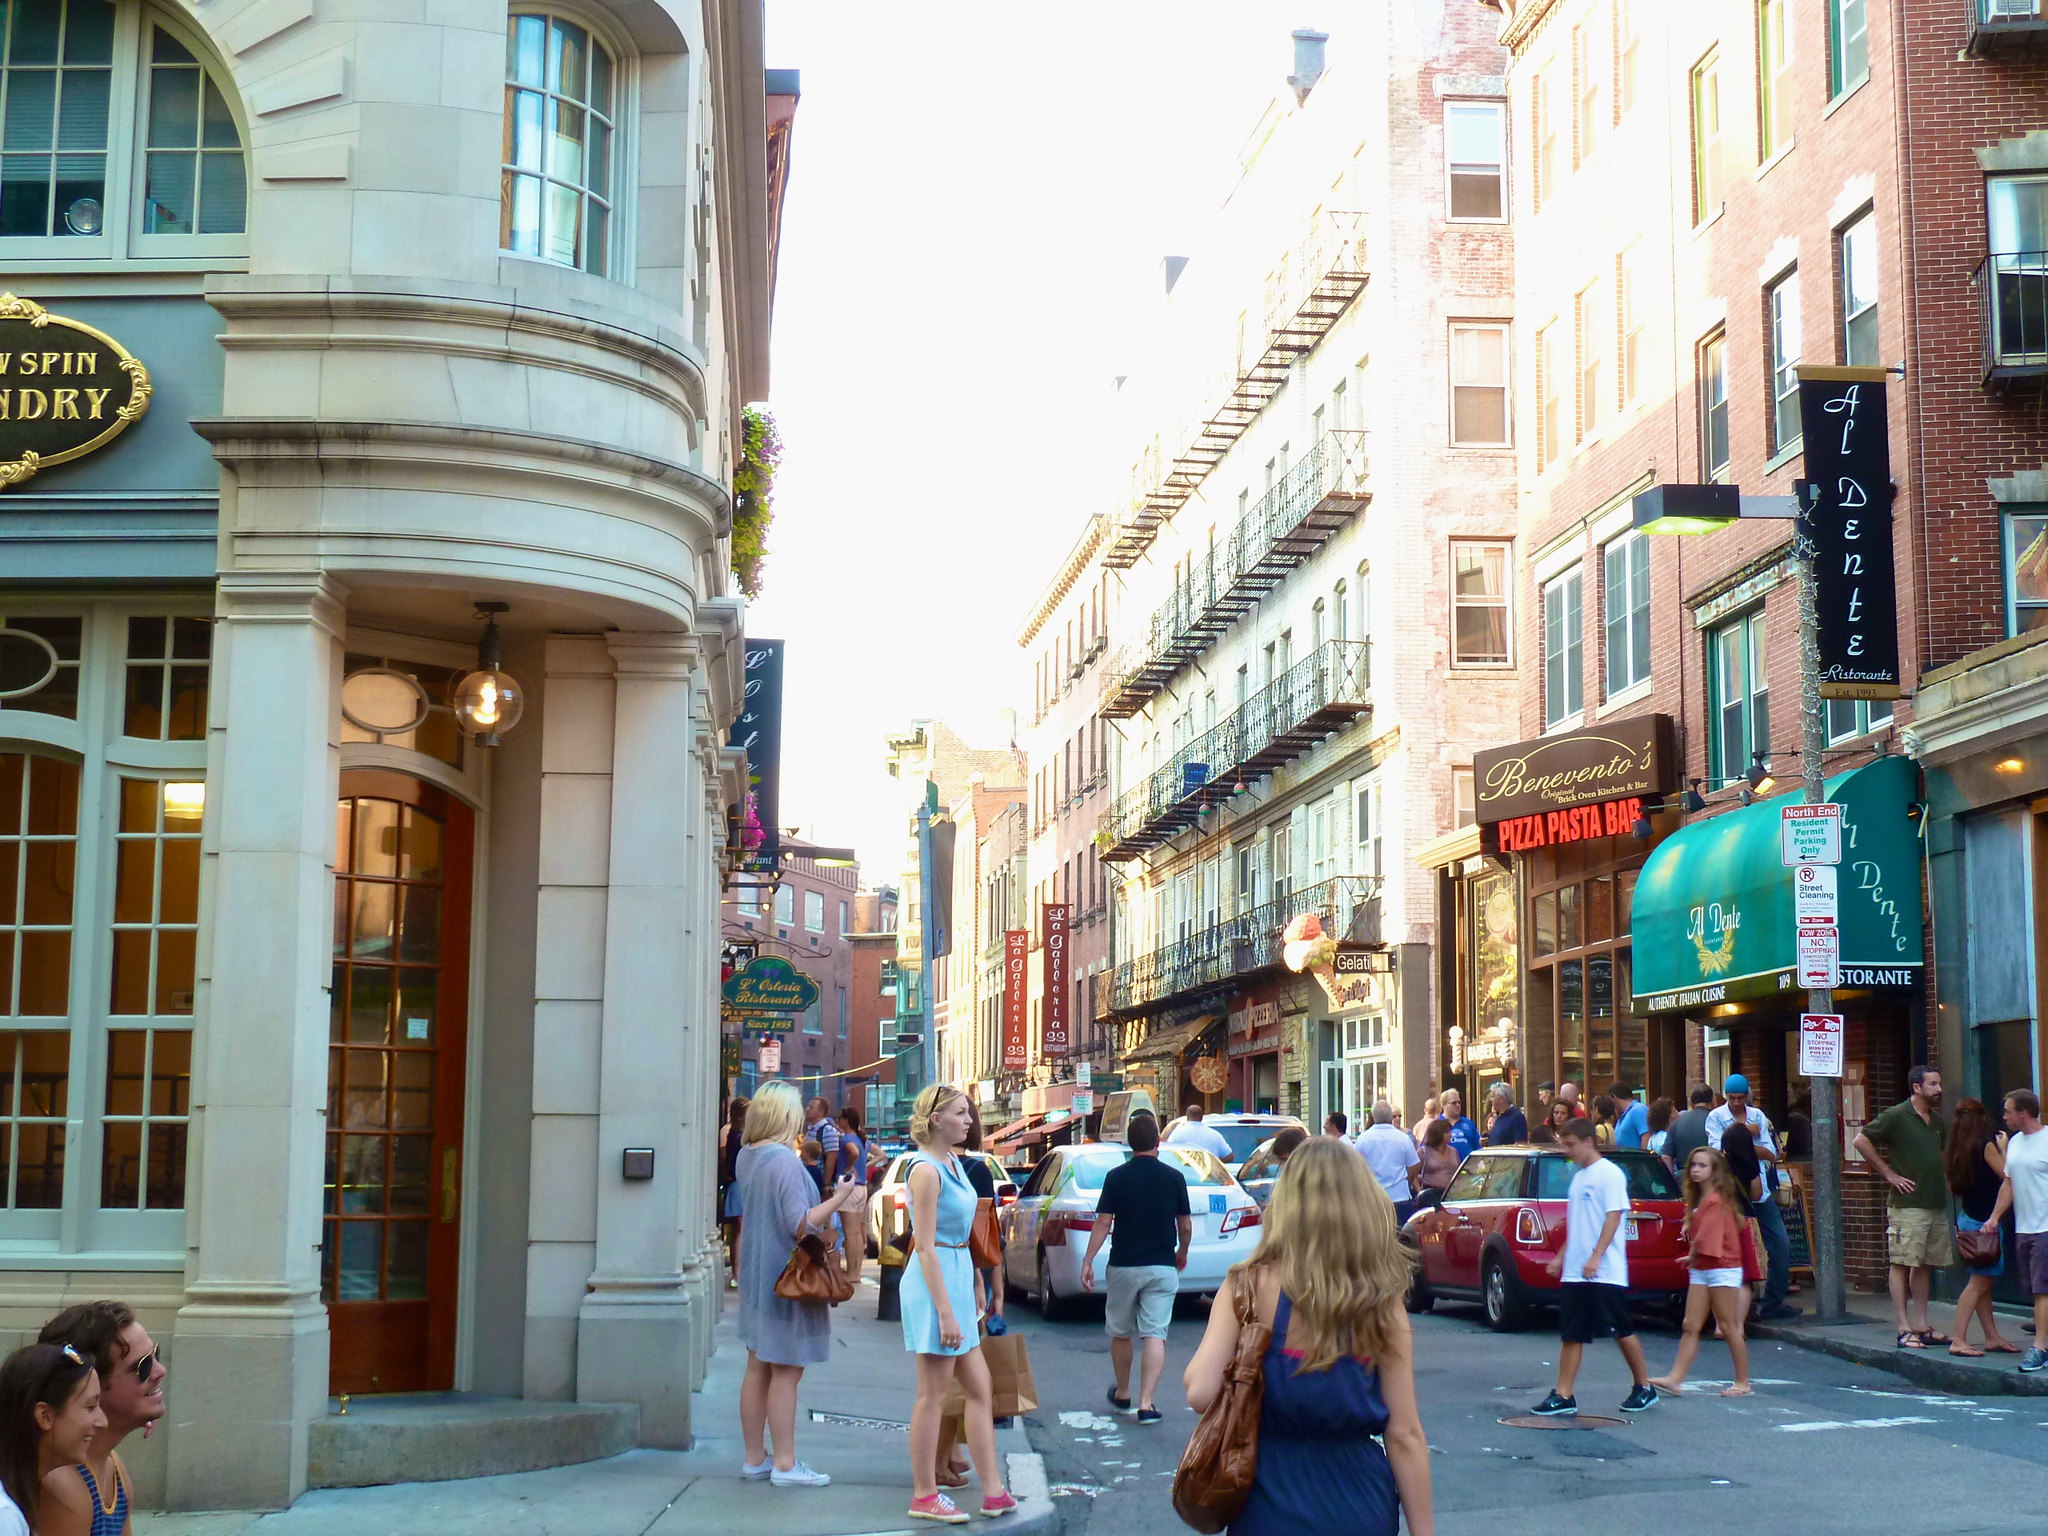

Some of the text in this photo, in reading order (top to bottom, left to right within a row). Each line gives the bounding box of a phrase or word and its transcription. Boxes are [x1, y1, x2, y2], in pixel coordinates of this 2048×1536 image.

[20, 352, 97, 375] SPIN
[1838, 477, 1867, 656] Dente
[1820, 664, 1893, 681] Ristorante
[1836, 689, 1877, 697] Est. 1993
[1480, 737, 1652, 801] Benevento's
[1541, 786, 1575, 801] Original
[1558, 781, 1648, 804] Brick Oven Kitchen & Bar
[1785, 806, 1837, 817] North End
[1499, 798, 1643, 852] PIZZA PASTA BAR
[1791, 818, 1829, 827] Resident
[1796, 828, 1824, 836] Permit
[1794, 837, 1827, 846] Parking
[1800, 846, 1820, 855] Only
[1799, 891, 1834, 900] Cleaning
[1852, 861, 1907, 952] Dente
[1687, 903, 1741, 940] Al Dente
[1801, 929, 1834, 937] TOW ZONE
[1337, 955, 1370, 970] Gelati
[759, 978, 802, 992] Osteria
[1778, 974, 1790, 989] 109
[736, 990, 803, 1005] Ristorante
[1648, 994, 1678, 1011] AUTHENTIC
[1679, 990, 1701, 1007] ITALIAN
[1701, 986, 1726, 1003] CUISINE
[746, 1020, 792, 1029] Since 1985
